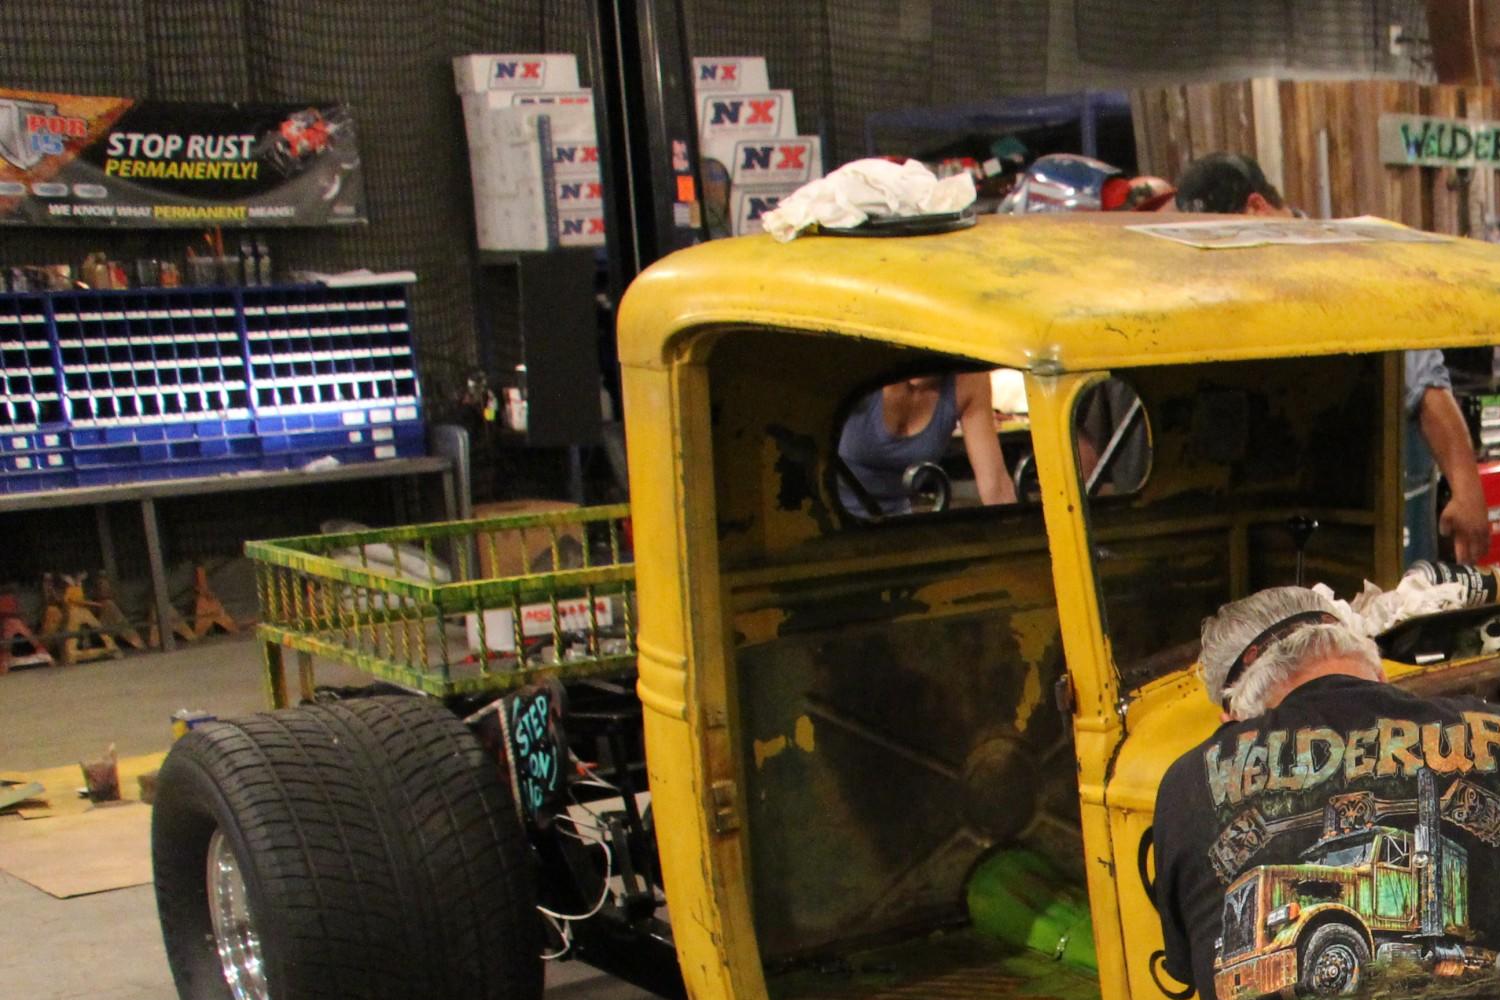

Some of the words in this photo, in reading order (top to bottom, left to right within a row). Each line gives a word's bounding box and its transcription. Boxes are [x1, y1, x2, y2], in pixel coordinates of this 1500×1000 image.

[495, 62, 541, 78] NX
[700, 65, 736, 81] NX
[711, 100, 775, 125] NX
[106, 132, 183, 158] STOP
[186, 134, 256, 160] RUST
[554, 147, 598, 163] NX
[741, 146, 806, 170] NX
[105, 159, 258, 180] PERMANENTLY!
[560, 183, 603, 200] NX
[48, 203, 71, 216] WE
[73, 204, 113, 217] KNOW
[116, 206, 151, 218] WHAT
[154, 205, 247, 219] PERMANENT
[563, 219, 606, 235] NX
[516, 694, 548, 757] STEP
[529, 750, 550, 779] ON
